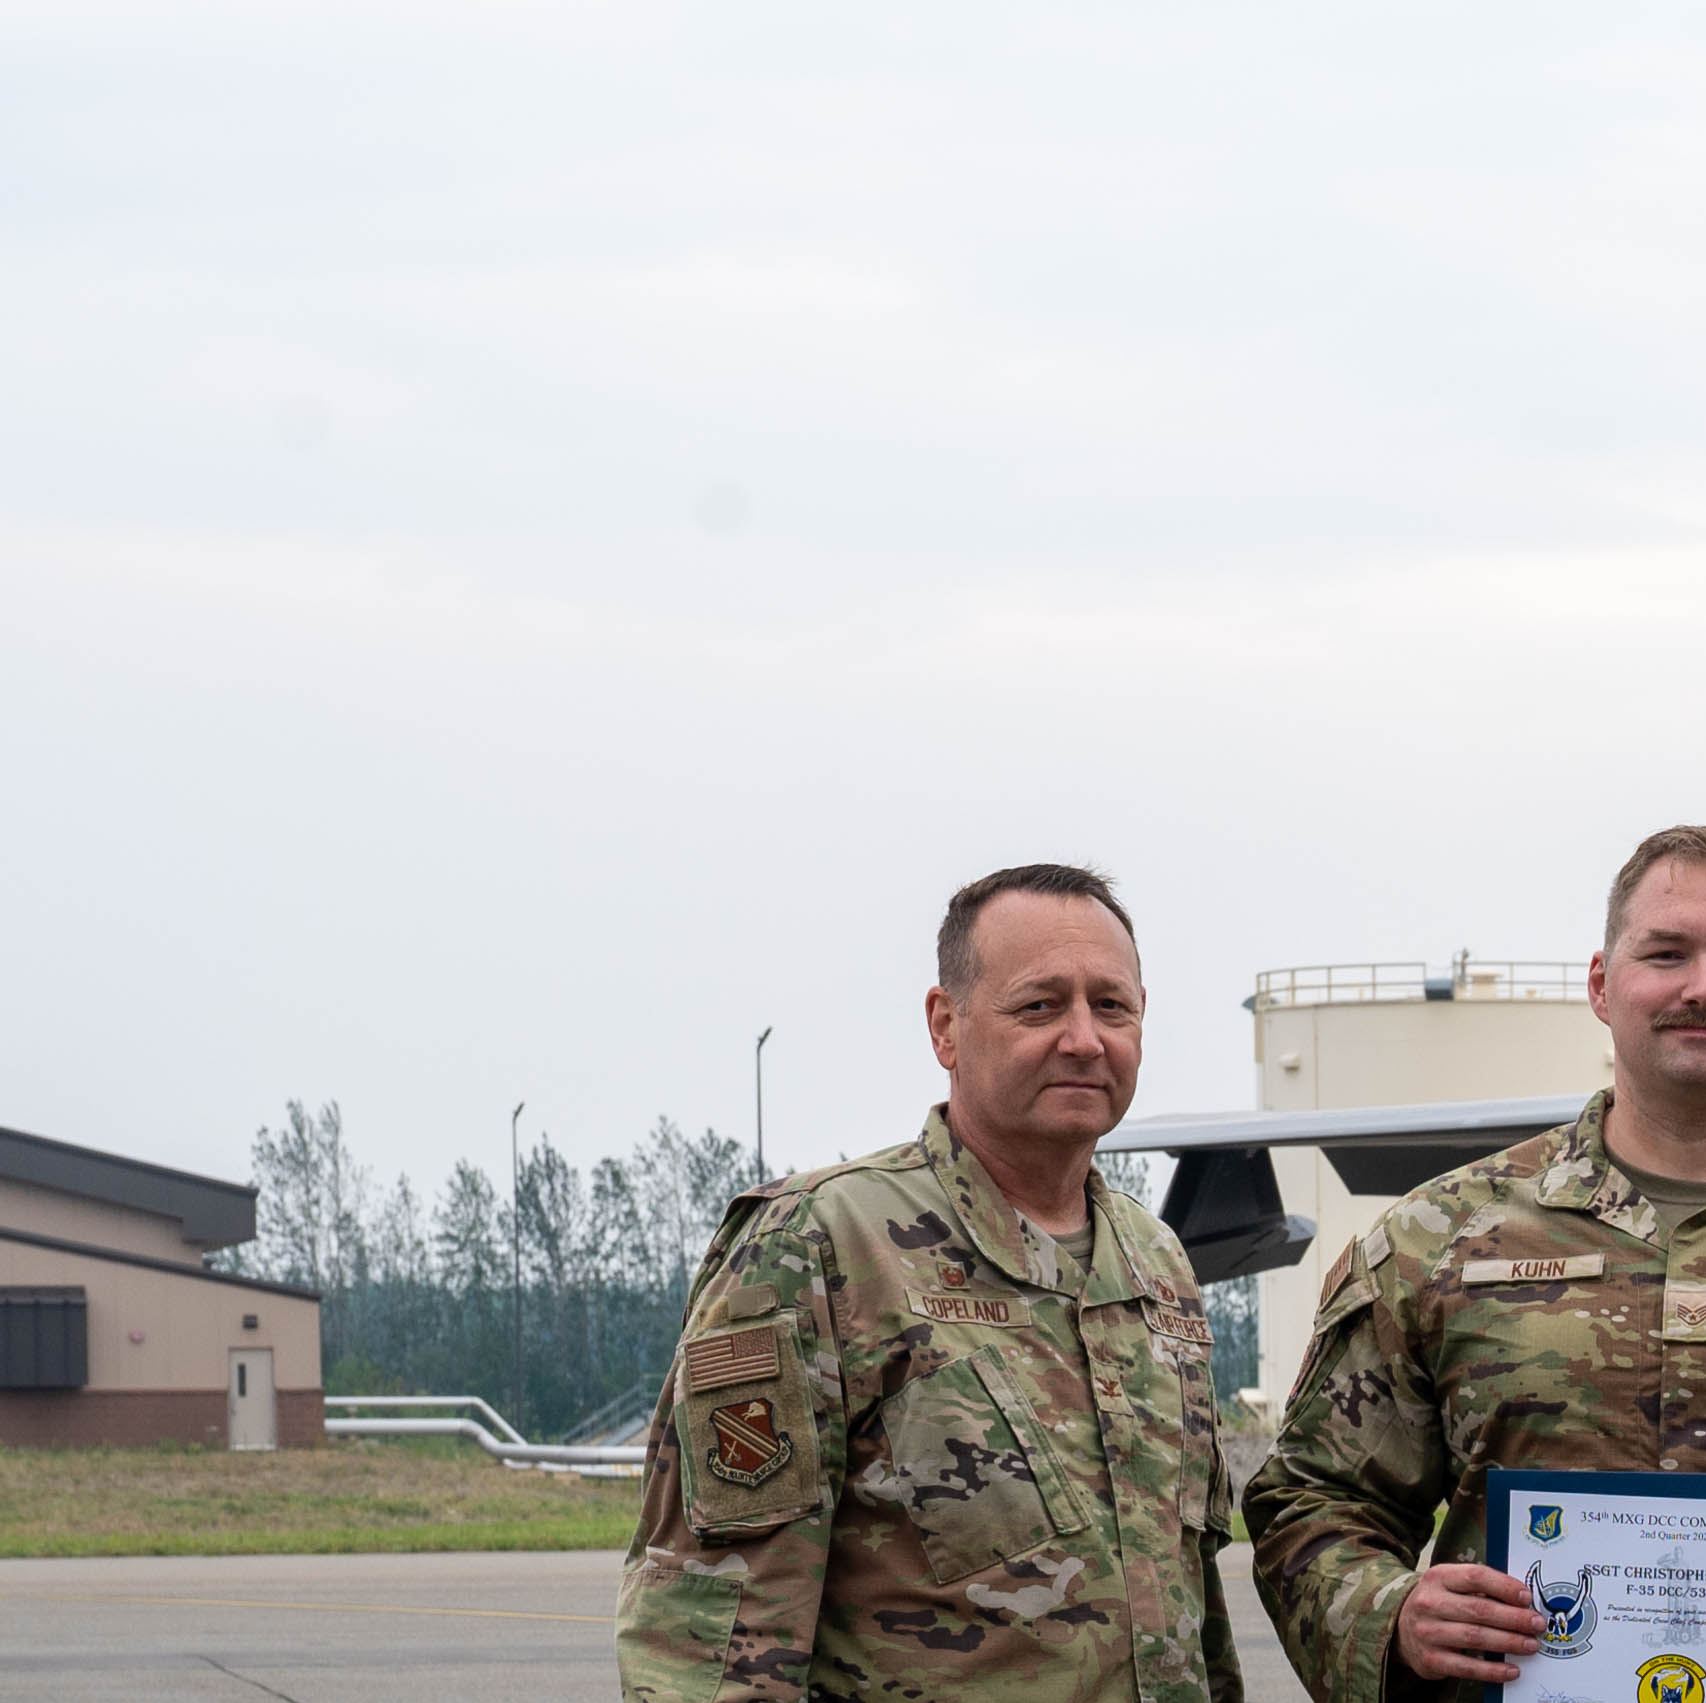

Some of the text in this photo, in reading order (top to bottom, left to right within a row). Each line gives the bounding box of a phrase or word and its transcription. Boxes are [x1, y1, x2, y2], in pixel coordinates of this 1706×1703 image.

[1511, 1259, 1567, 1279] KUHN
[922, 1296, 1010, 1323] COPELAND
[1580, 1511, 1609, 1523] 354th
[1612, 1513, 1644, 1526] MXG
[1648, 1515, 1678, 1527] DCC
[1639, 1529, 1657, 1540] 2nd
[1658, 1531, 1691, 1542] Quarter
[1584, 1564, 1621, 1577] SSGT
[1626, 1584, 1655, 1596] F-35
